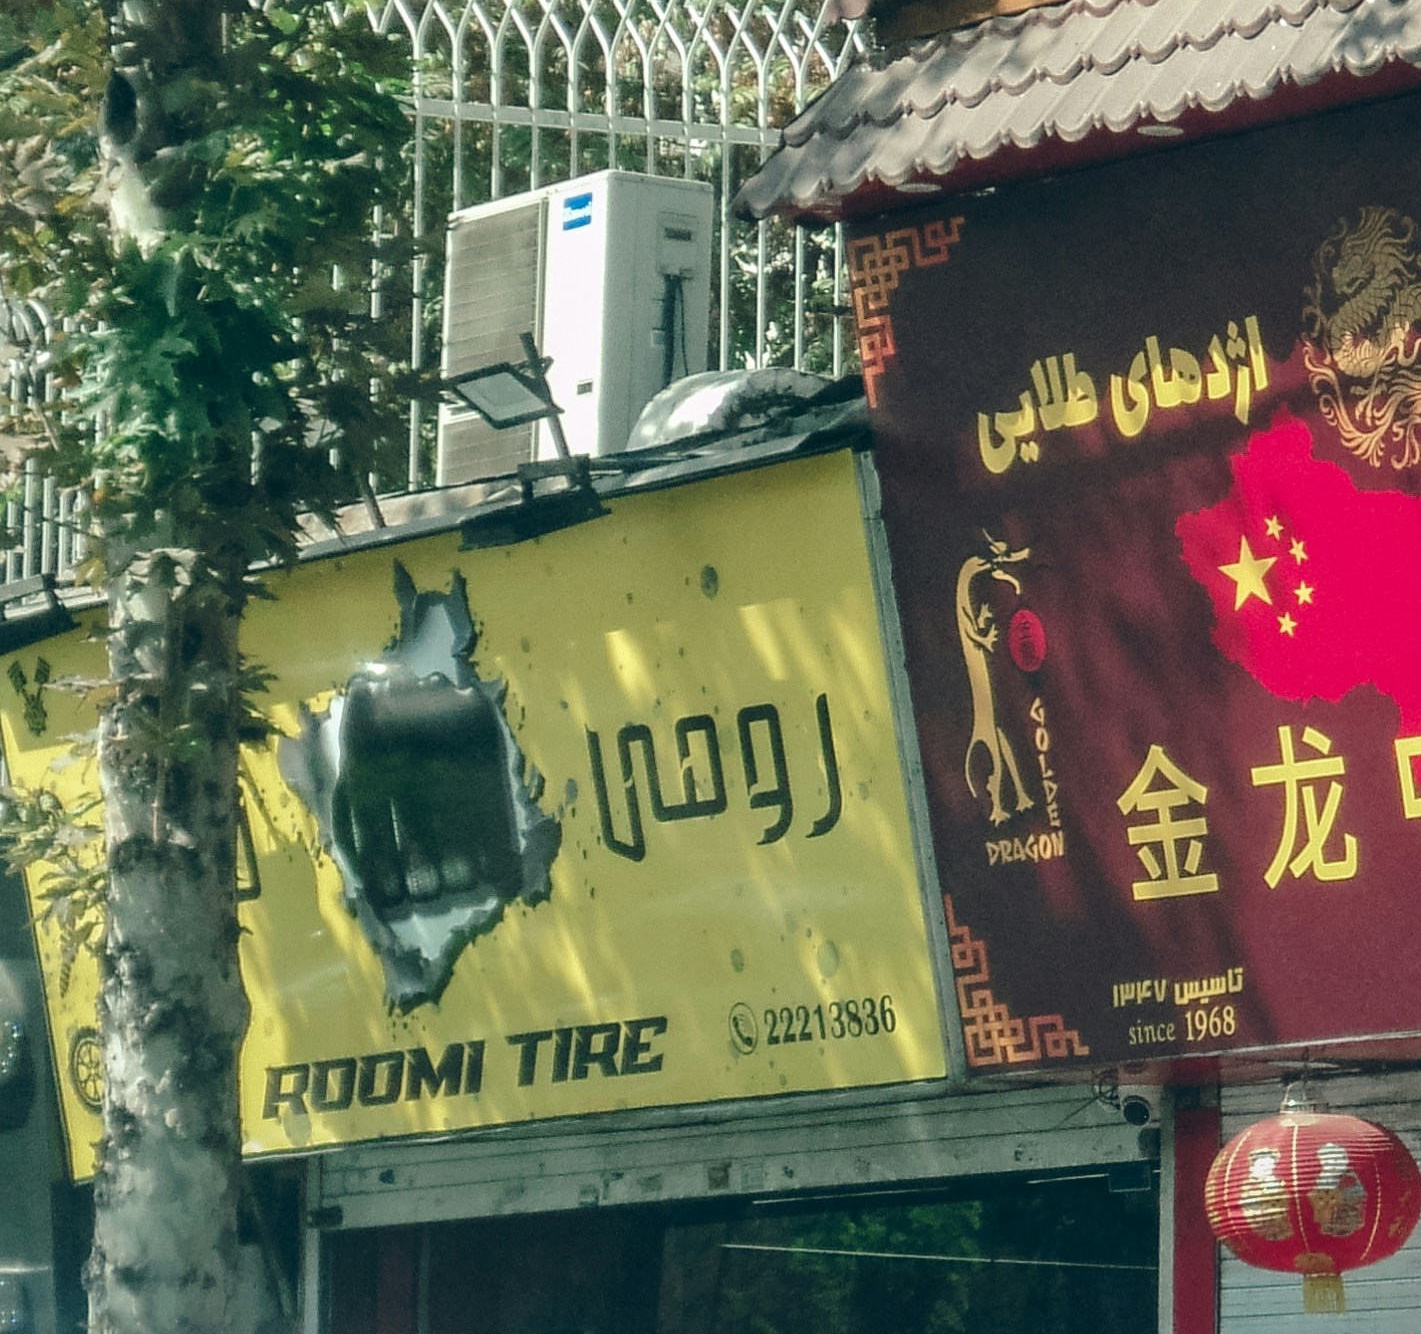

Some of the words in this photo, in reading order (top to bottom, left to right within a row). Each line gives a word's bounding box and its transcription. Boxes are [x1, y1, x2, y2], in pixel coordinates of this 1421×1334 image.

[1110, 315, 1269, 437] اژدهای
[977, 352, 1099, 474] طلایی
[985, 830, 1065, 866] DRAGON
[1174, 966, 1244, 1006] تاسیس
[763, 994, 897, 1046] 22213836
[1128, 1019, 1177, 1045] since
[1185, 1005, 1236, 1042] 1968
[261, 1039, 486, 1121] ROOMI
[505, 1015, 668, 1088] TIRE
